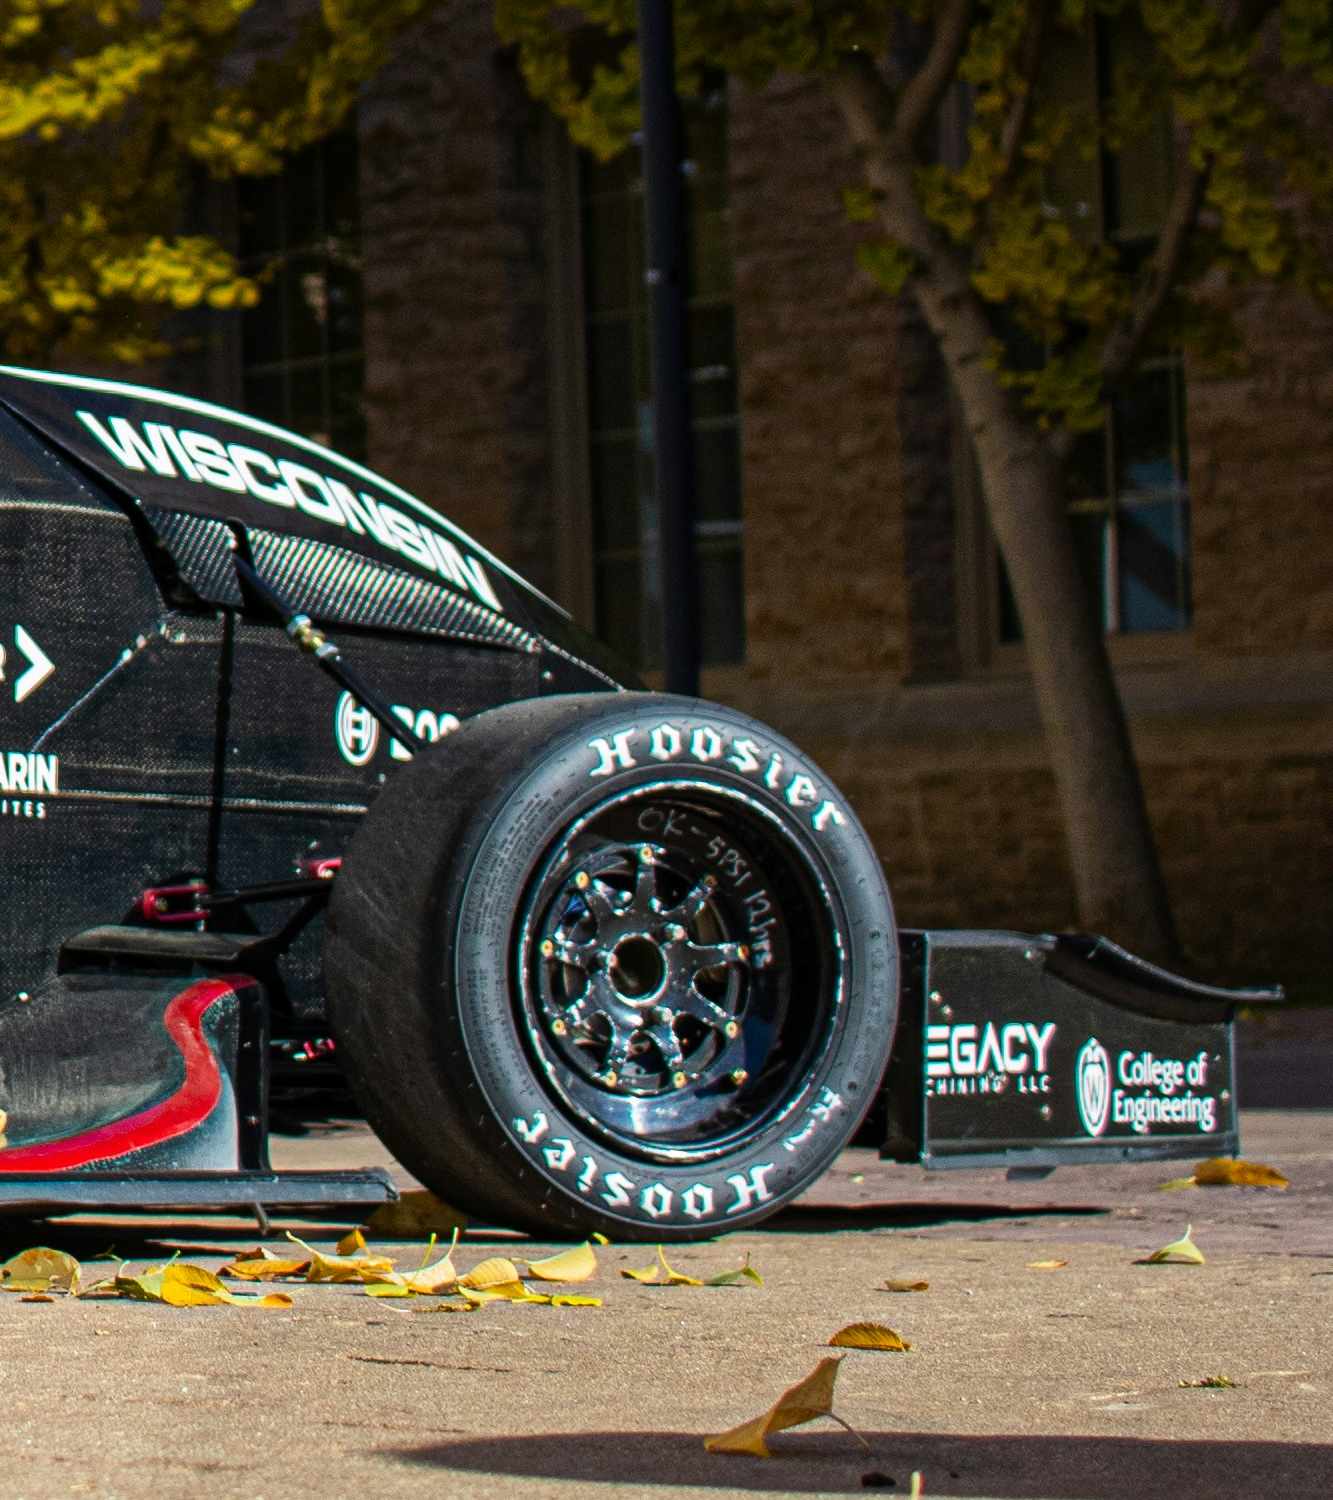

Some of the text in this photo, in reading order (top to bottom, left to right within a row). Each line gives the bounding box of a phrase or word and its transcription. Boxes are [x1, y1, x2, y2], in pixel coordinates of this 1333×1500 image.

[76, 410, 503, 612] WISCONSIN
[589, 722, 849, 833] Hoosier
[1016, 1075, 1051, 1094] LLC
[1112, 1088, 1217, 1134] Engineering
[1117, 1050, 1209, 1096] College of
[514, 1111, 775, 1219] Hoosier
